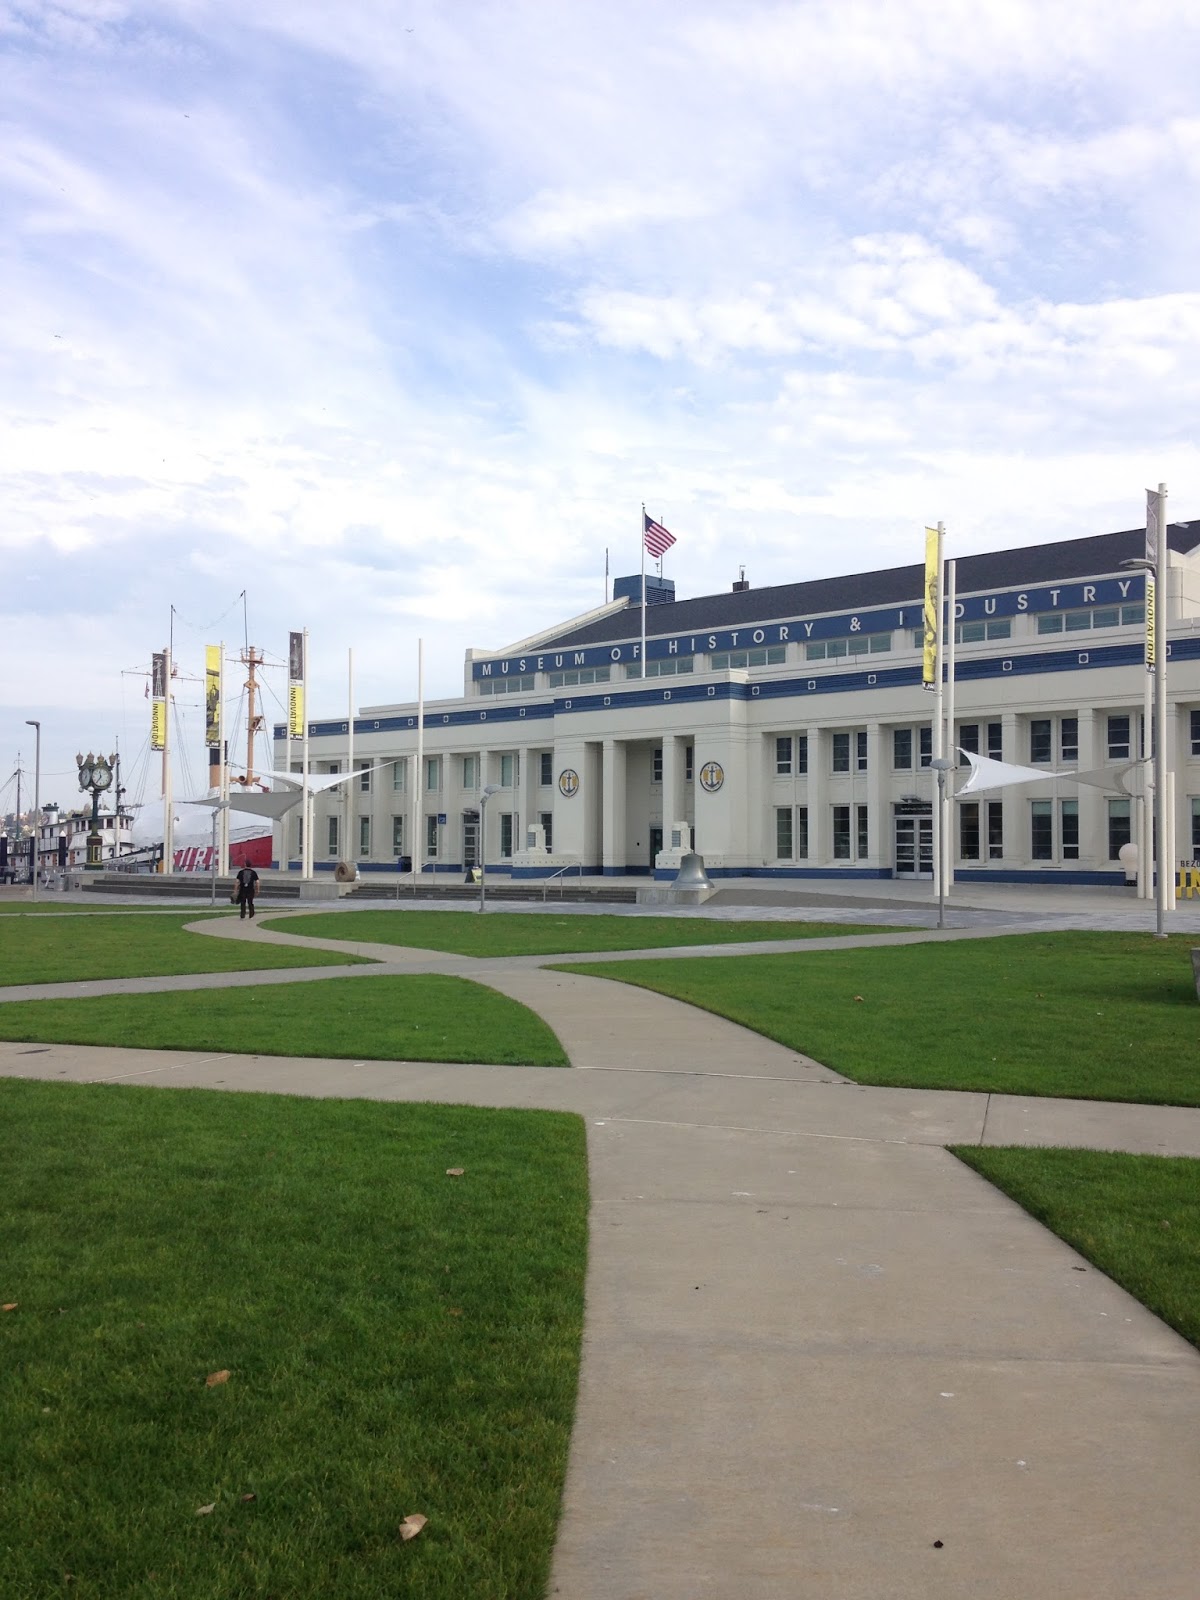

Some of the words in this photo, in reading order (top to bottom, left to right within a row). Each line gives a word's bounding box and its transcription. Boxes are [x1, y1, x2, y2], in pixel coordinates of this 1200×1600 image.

[482, 652, 585, 676] MUSEUM
[611, 646, 640, 660] OF
[669, 622, 814, 654] HISTORY
[850, 616, 861, 631] &
[899, 580, 1131, 626] IDUSTRY
